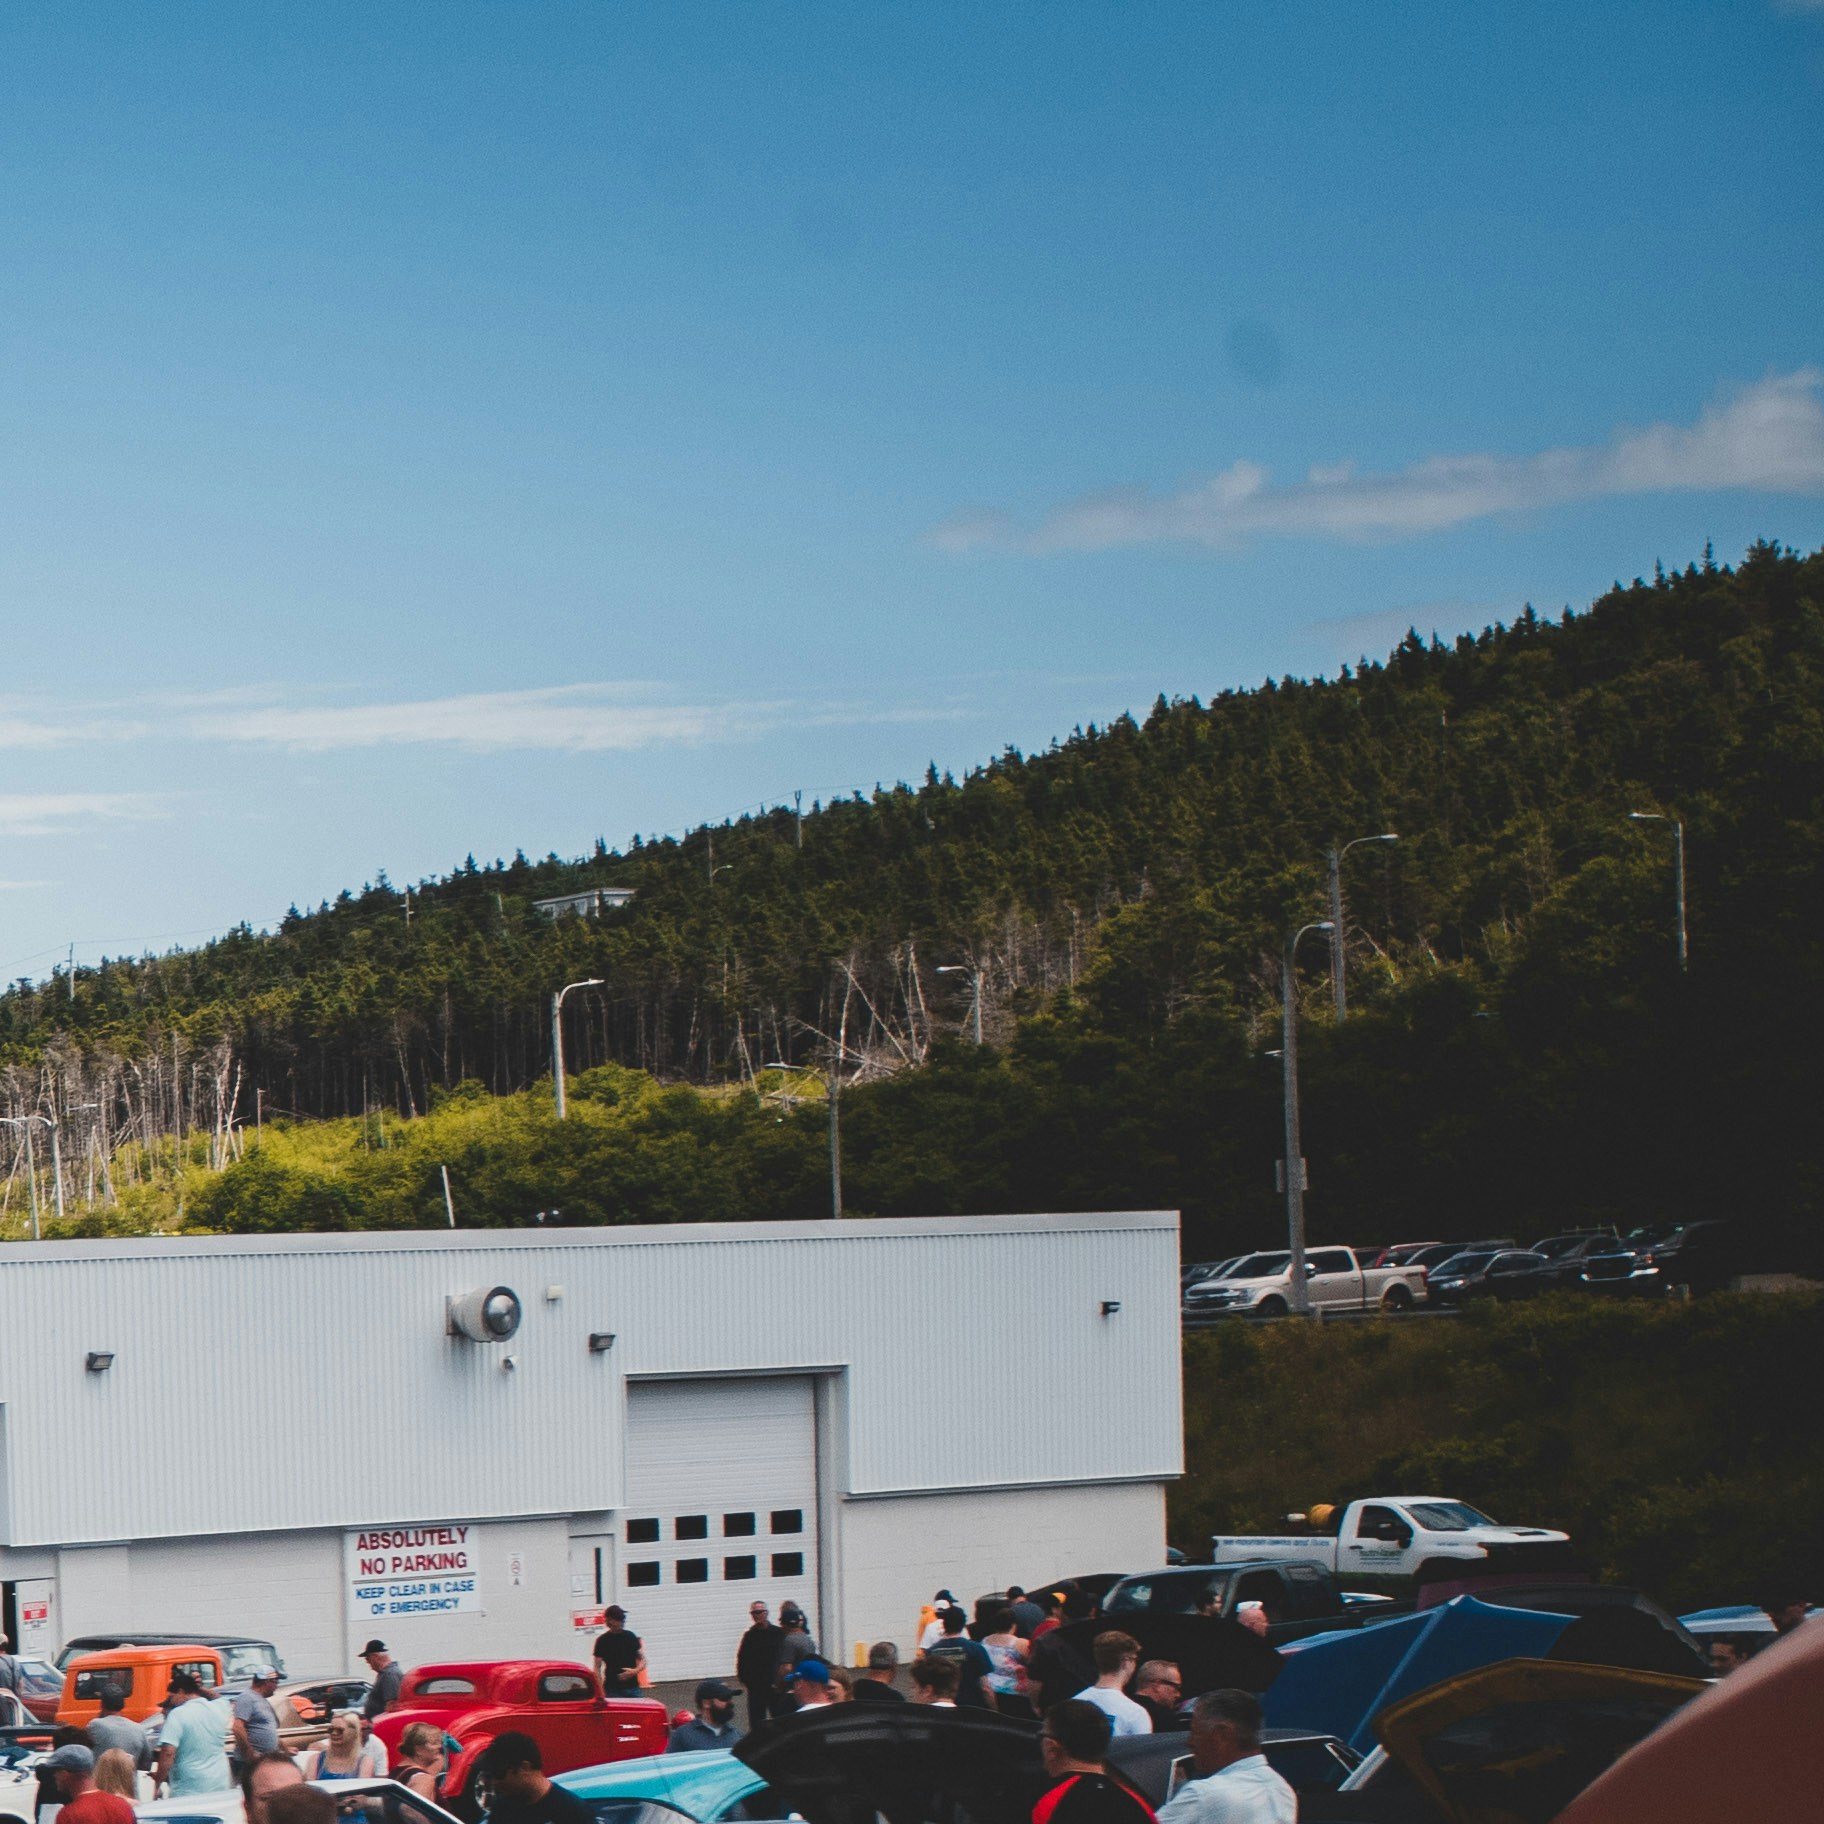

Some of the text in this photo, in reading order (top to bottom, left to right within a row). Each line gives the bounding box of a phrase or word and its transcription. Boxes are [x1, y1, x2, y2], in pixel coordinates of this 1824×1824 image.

[356, 1527, 469, 1551] ABSOLUTELY
[360, 1552, 468, 1575] NO PARKING
[356, 1580, 475, 1599] KEEP CLEAR IN CASE
[371, 1598, 460, 1615] OF EMERGENCY
